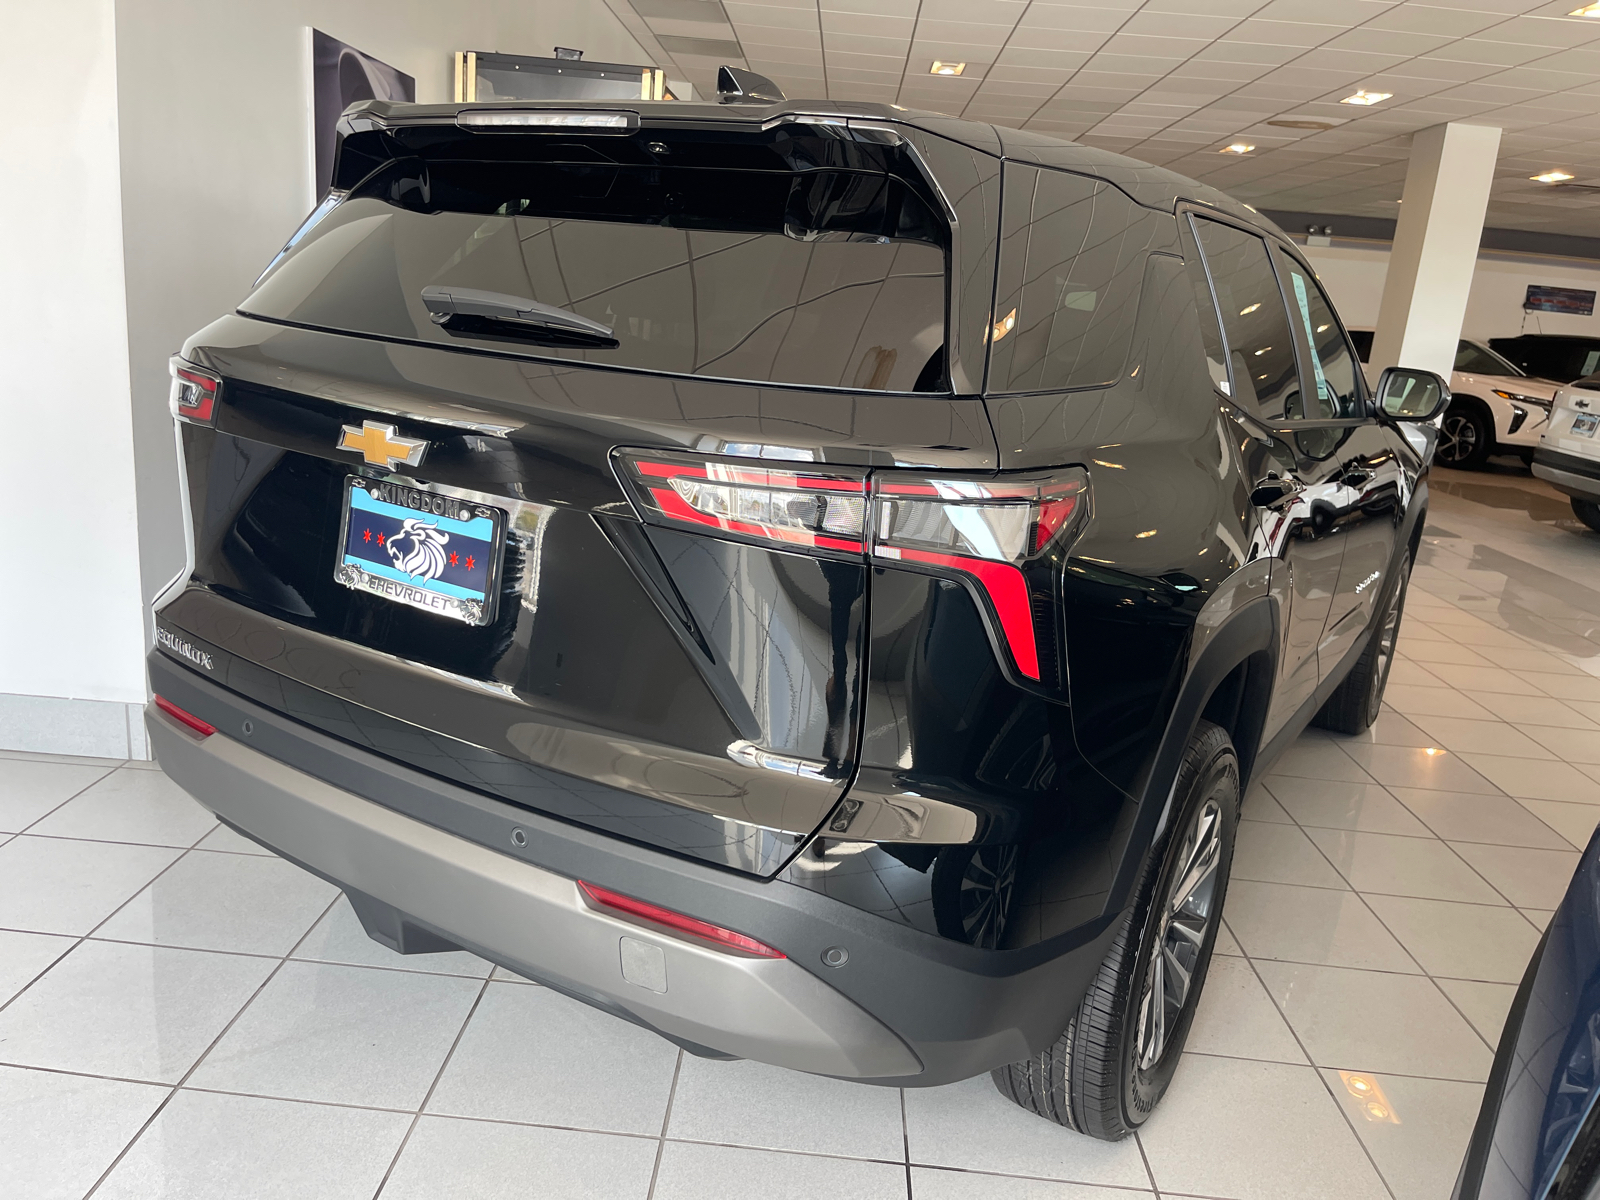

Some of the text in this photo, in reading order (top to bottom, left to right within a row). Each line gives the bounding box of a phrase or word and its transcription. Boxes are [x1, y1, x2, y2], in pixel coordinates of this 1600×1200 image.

[379, 484, 460, 519] KINGDOM
[368, 578, 450, 610] CHEVROLET
[157, 626, 214, 670] EQUINOX
